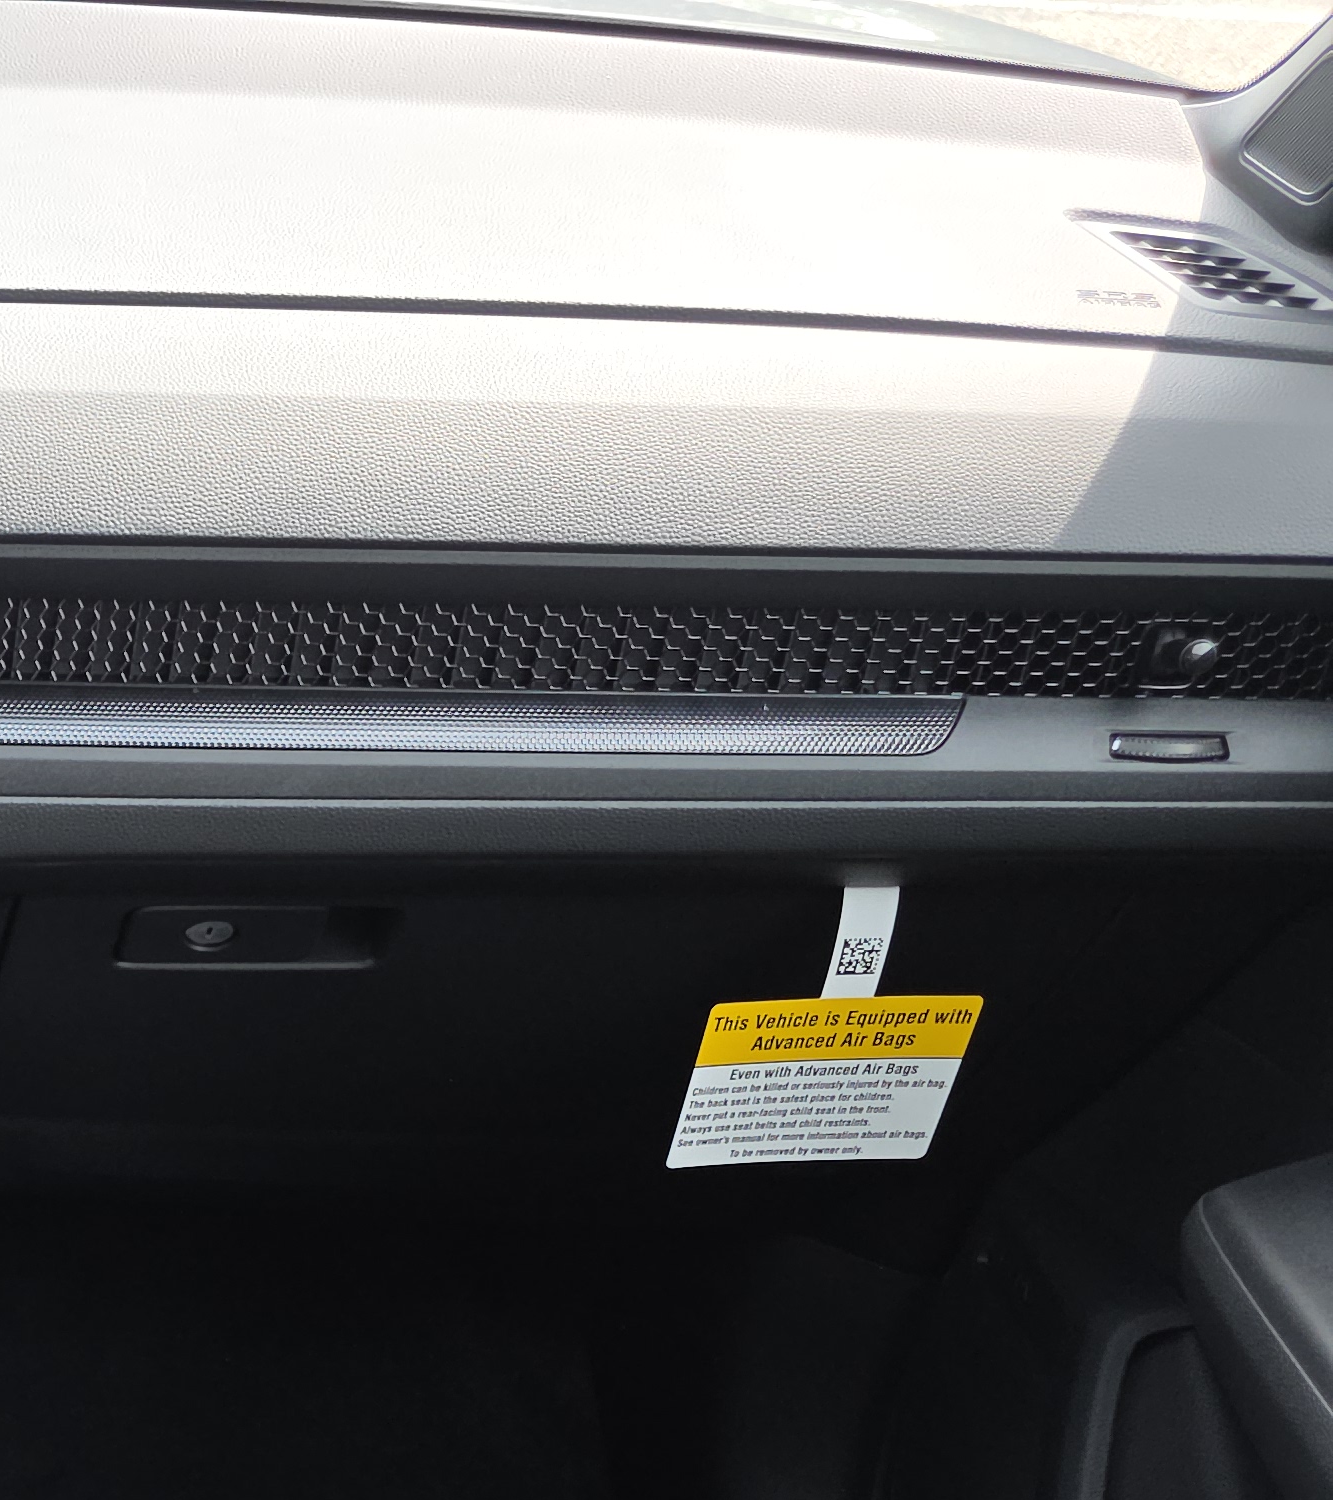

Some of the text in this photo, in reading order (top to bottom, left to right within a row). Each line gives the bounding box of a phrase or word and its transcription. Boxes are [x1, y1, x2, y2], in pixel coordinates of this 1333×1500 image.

[714, 1009, 973, 1032] This Vehicle is Equipped with
[751, 1032, 916, 1051] Advanced Air Bags
[729, 1063, 919, 1081] Even with Advanced Air Bags
[692, 1086, 729, 1096] Children
[732, 1085, 747, 1093] can
[750, 1084, 761, 1092] be
[763, 1082, 789, 1092] killed
[802, 1081, 845, 1090] seriously
[846, 1080, 879, 1090] injured
[881, 1079, 892, 1089] by
[894, 1079, 909, 1088] the
[911, 1079, 926, 1088] air
[927, 1079, 948, 1089] bag.
[689, 1092, 894, 1109] The back seat is the safest place for children.
[684, 1113, 710, 1122] Never
[713, 1111, 728, 1121] put
[737, 1108, 788, 1118] rear-facing
[790, 1106, 813, 1116] child
[814, 1106, 836, 1115] seat
[837, 1106, 847, 1115] in
[849, 1105, 864, 1114] the
[866, 1105, 891, 1114] front.
[680, 1126, 712, 1135] Always
[733, 1122, 753, 1131] seat
[754, 1120, 777, 1130] belts
[779, 1120, 798, 1129] and
[798, 1119, 823, 1128] child
[824, 1119, 871, 1127] restraints.
[677, 1130, 928, 1148] See owner's manual for more information about air bags.
[729, 1145, 863, 1158] To be removed by owner only.
